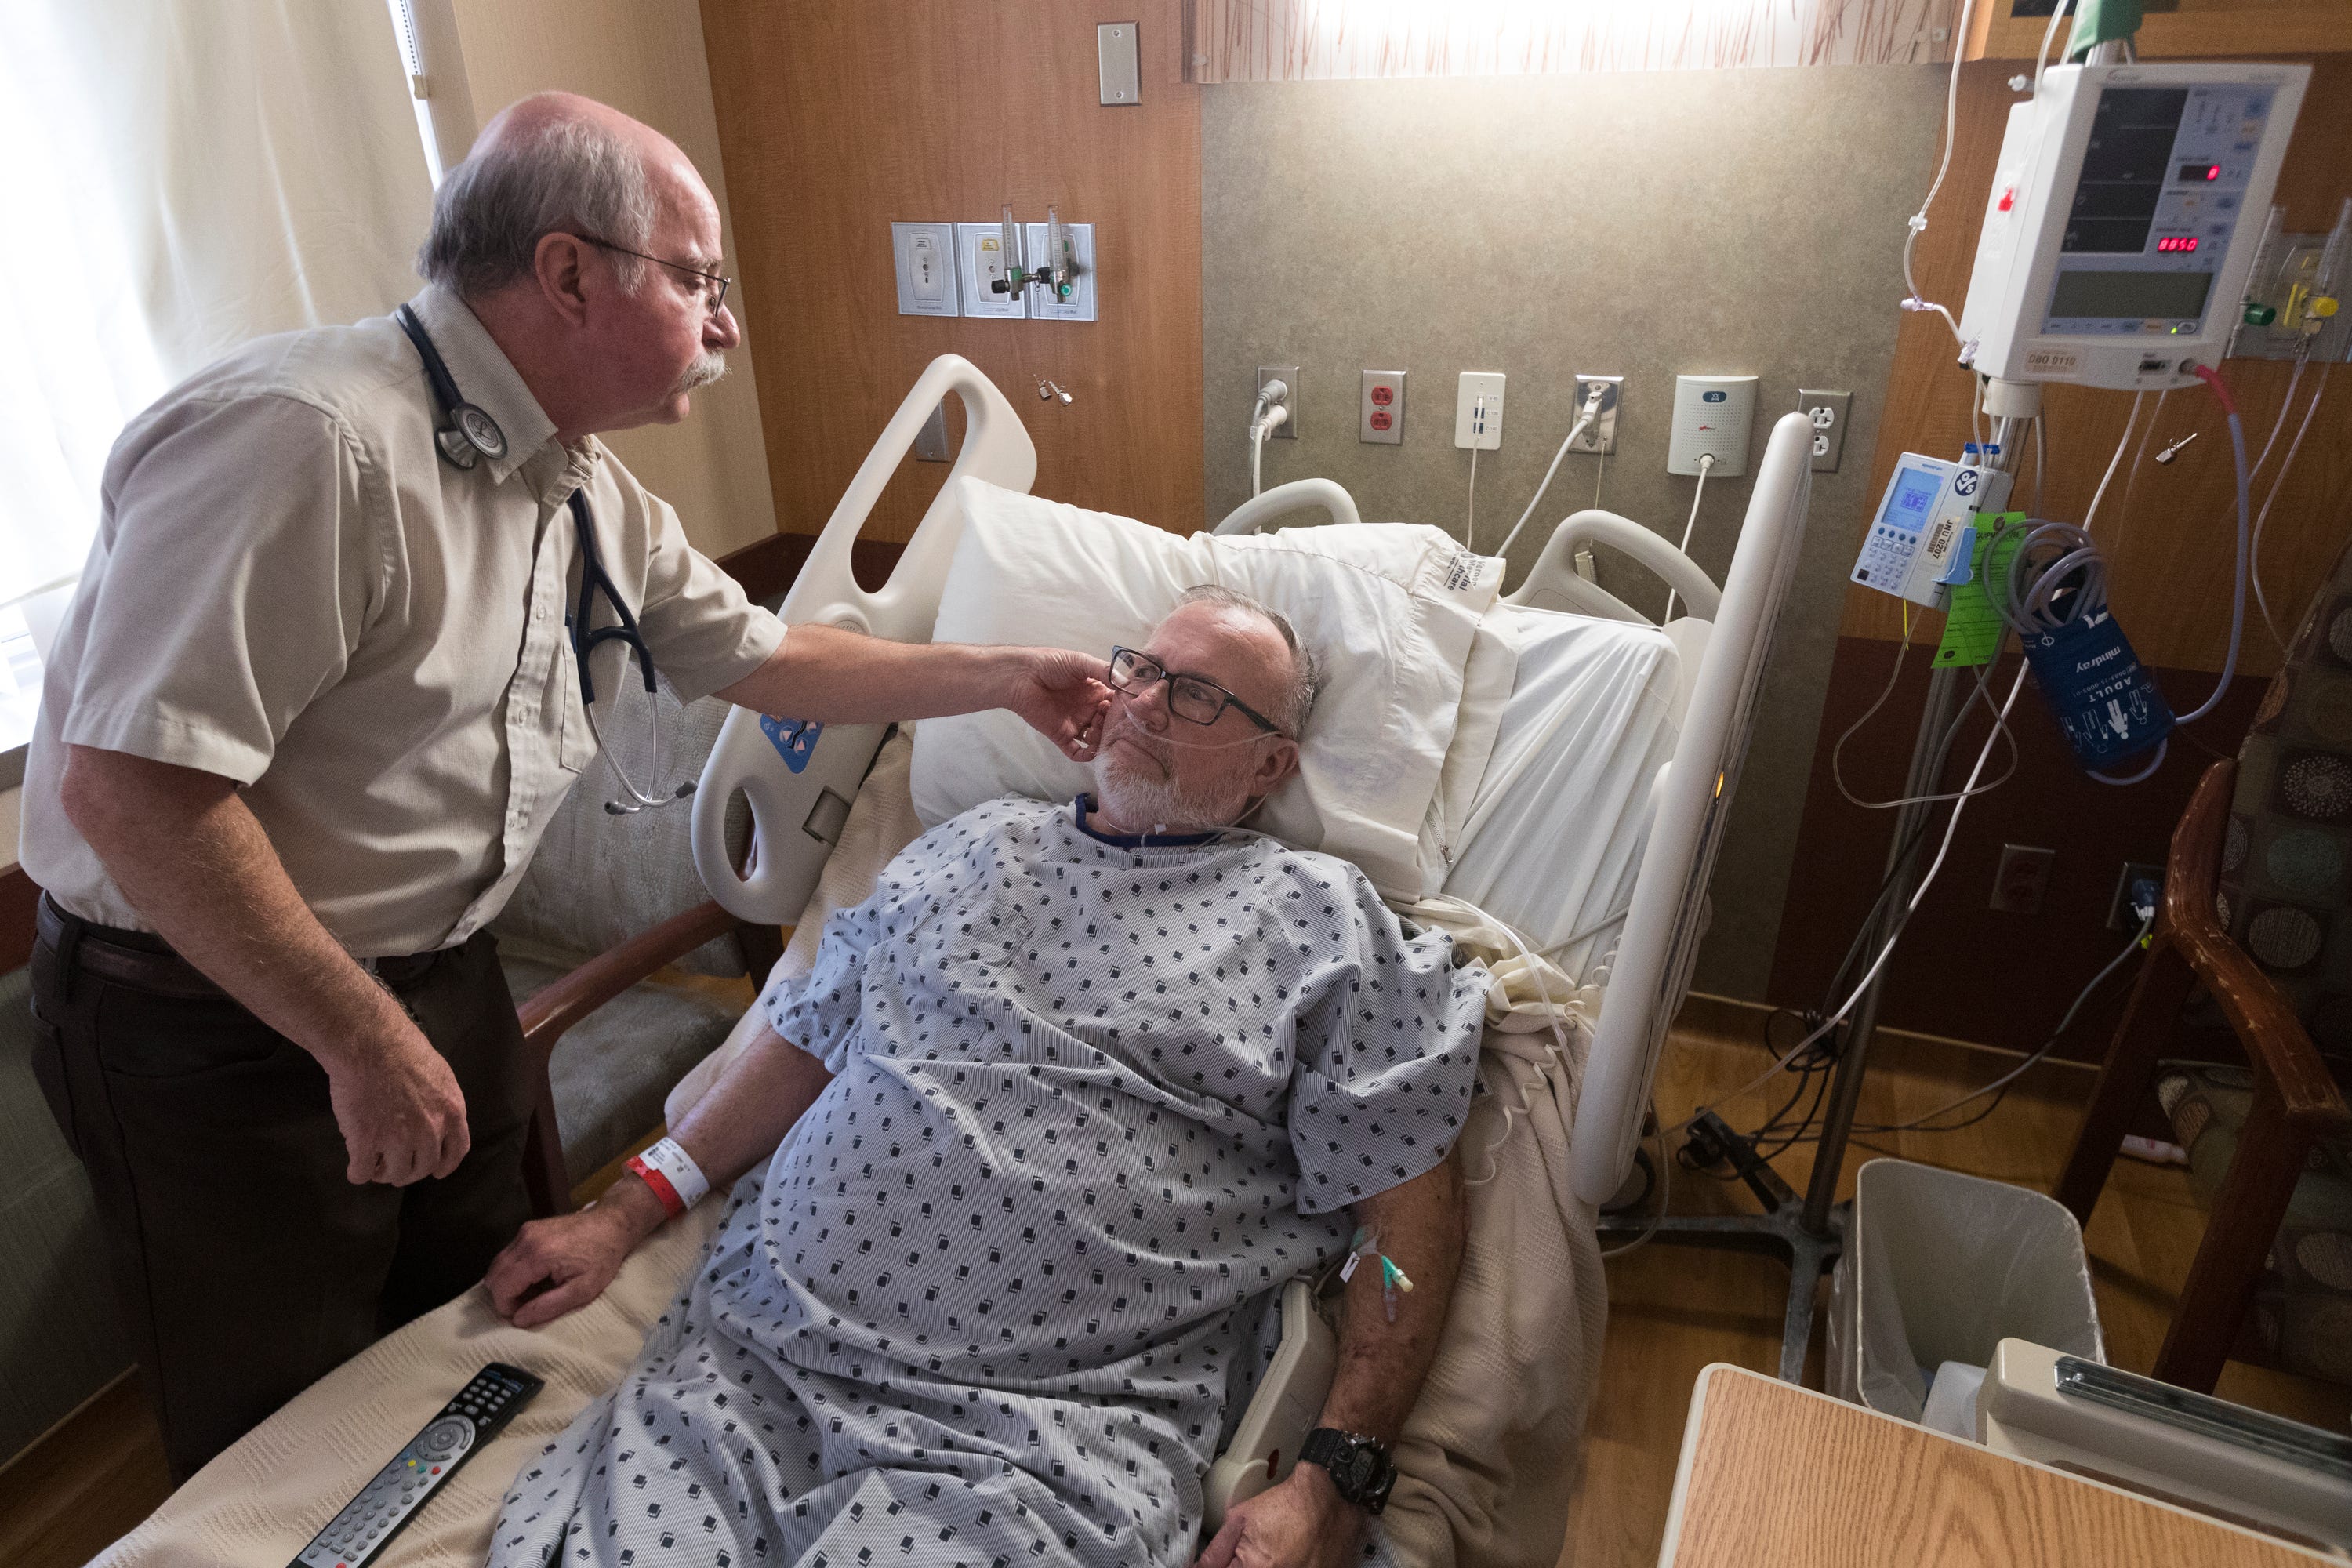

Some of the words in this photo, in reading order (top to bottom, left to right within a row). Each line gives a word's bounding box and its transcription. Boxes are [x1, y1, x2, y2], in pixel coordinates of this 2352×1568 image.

[1942, 519, 1953, 539] JNU
[1933, 539, 1947, 560] 0207
[2076, 645, 2121, 673] mindray
[2090, 677, 2131, 702] ADULT
